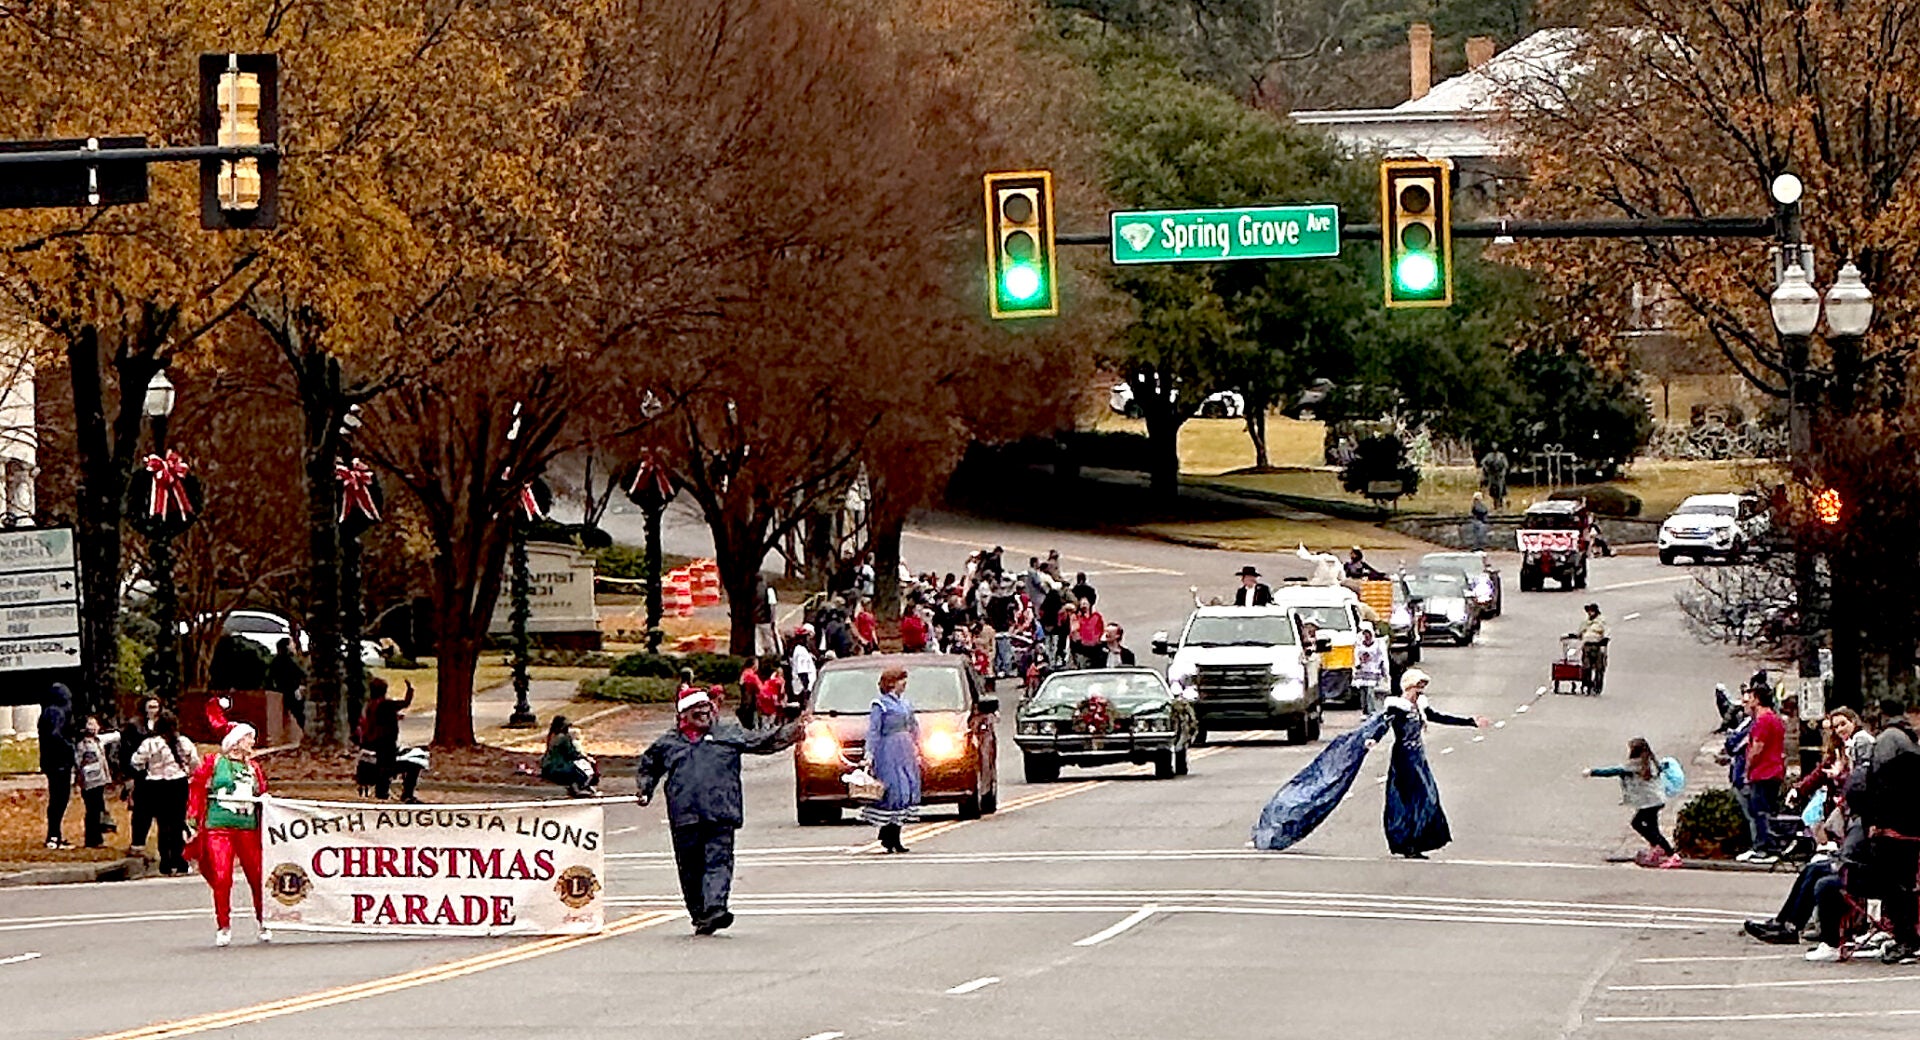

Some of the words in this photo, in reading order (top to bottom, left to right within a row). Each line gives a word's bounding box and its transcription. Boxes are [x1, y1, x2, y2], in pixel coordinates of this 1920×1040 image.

[1161, 217, 1230, 257] Spring
[1238, 214, 1299, 247] Grove
[1306, 212, 1331, 232] Ave
[267, 812, 366, 845] NORTH
[375, 810, 506, 832] AUGUSTA
[515, 816, 599, 851] LIONS
[311, 846, 556, 880] CHRISTMAS
[351, 894, 516, 926] PARADE
